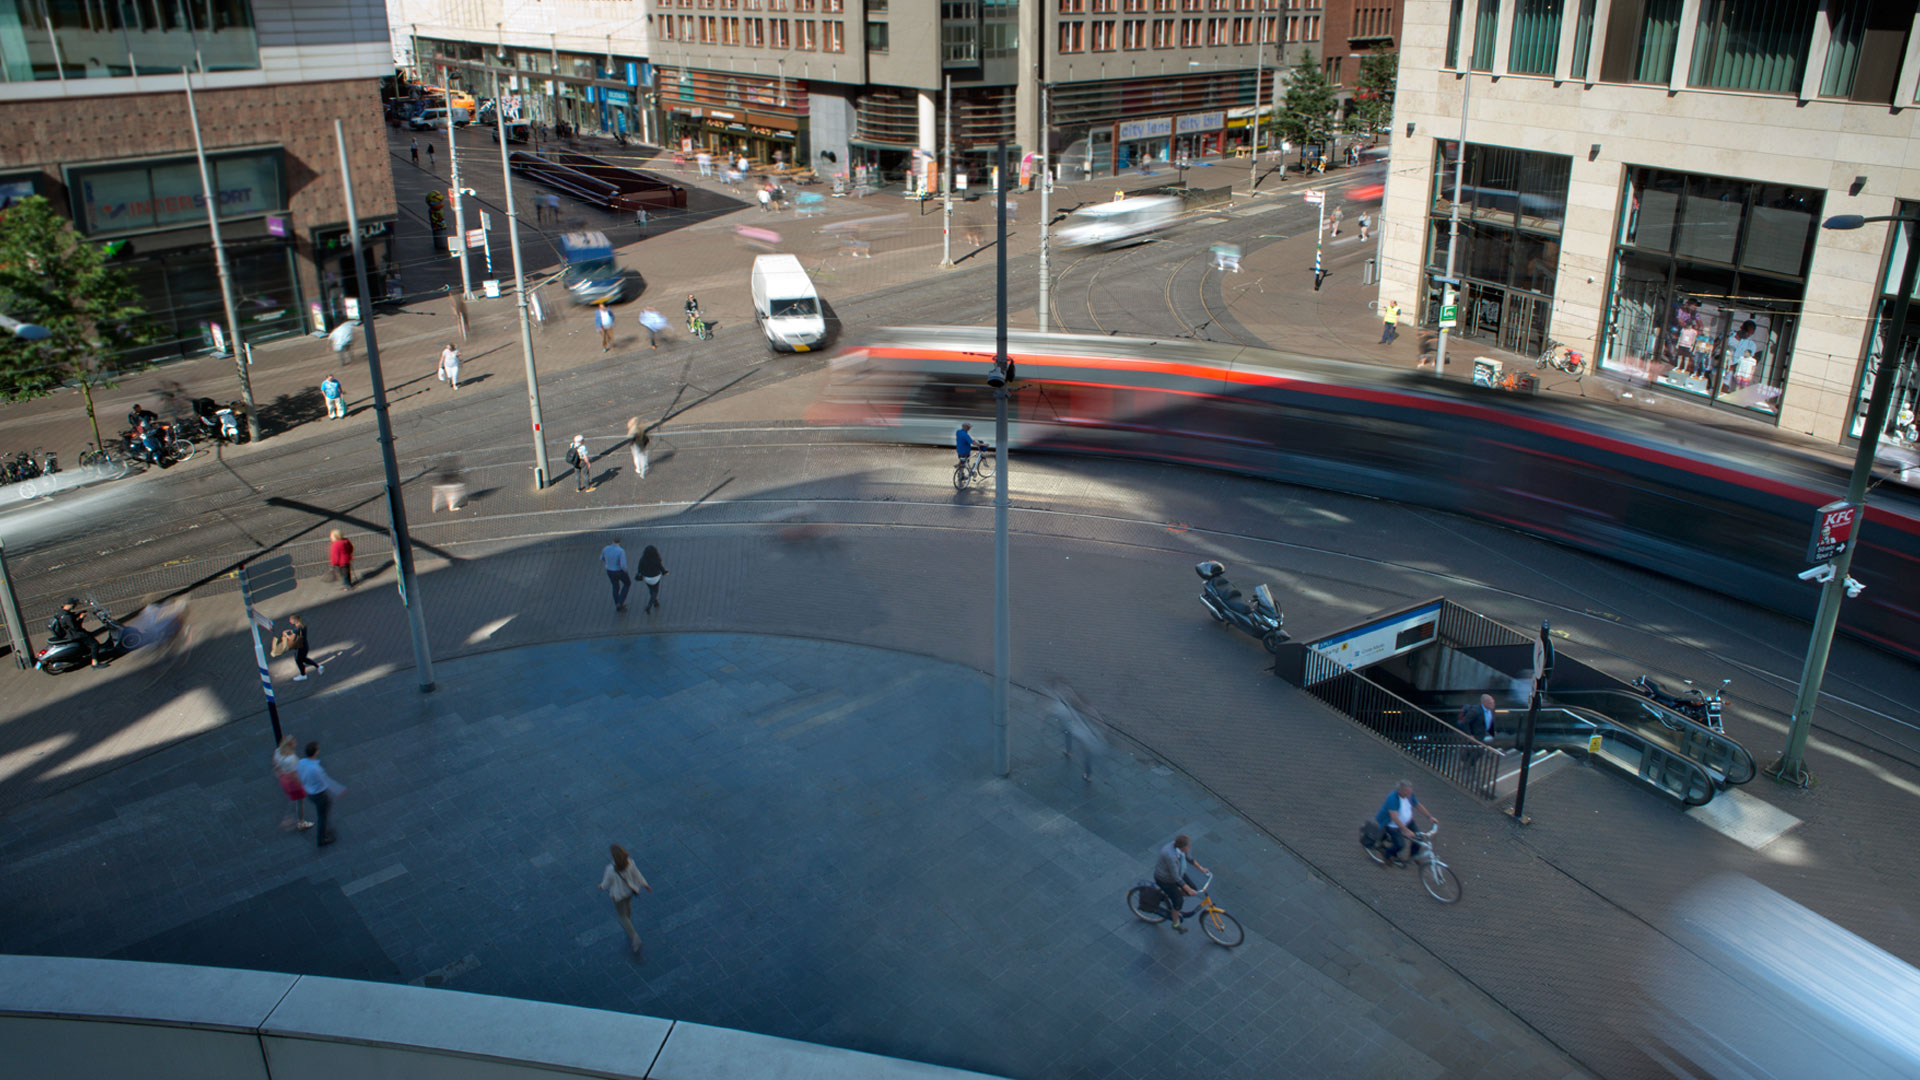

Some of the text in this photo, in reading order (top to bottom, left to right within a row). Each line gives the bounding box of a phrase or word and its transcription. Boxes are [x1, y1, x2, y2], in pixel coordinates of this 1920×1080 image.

[1121, 120, 1170, 138] city lens
[1179, 113, 1222, 131] city bril
[128, 187, 253, 218] INTERSORT
[1823, 508, 1854, 526] KFC
